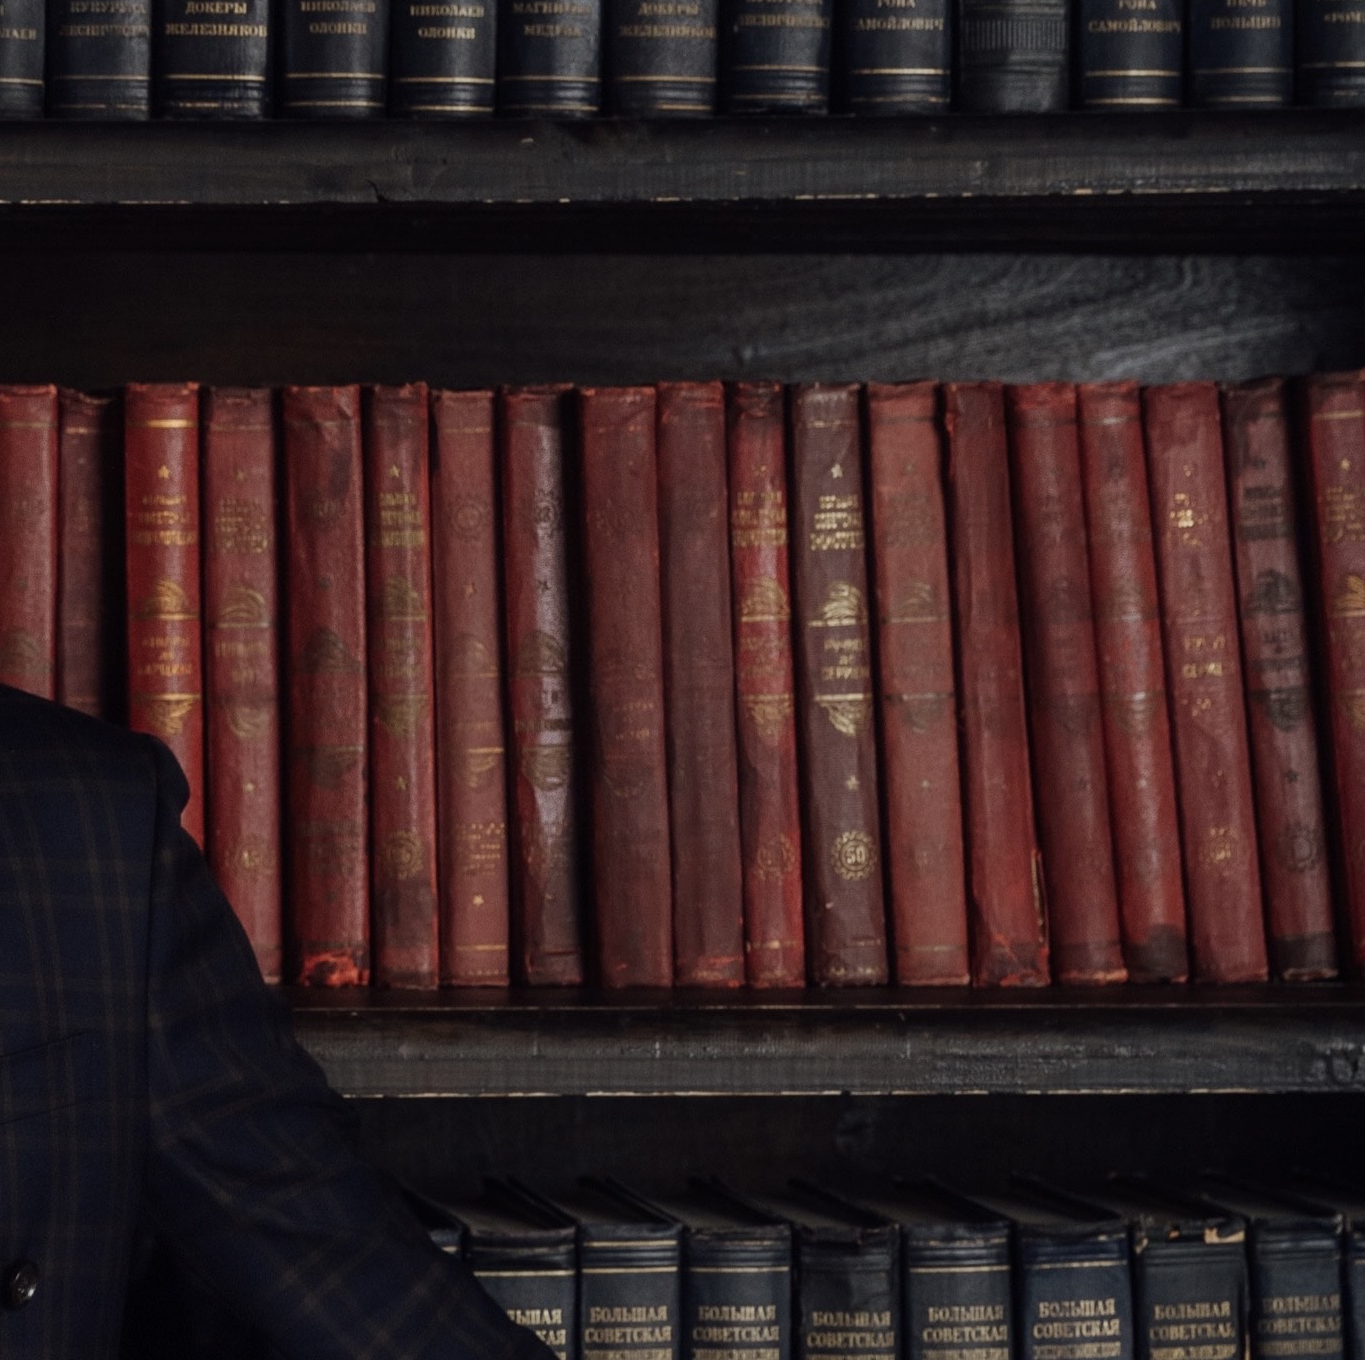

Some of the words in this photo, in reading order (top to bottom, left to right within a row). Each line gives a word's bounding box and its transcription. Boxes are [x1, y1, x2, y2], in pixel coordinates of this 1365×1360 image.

[186, 1, 249, 14] ДОКЕРЫ
[166, 23, 268, 38] ЖЕЛЕЗНЯКОВ
[845, 845, 865, 865] 50
[588, 1306, 669, 1321] БОЛЬШАЯ
[698, 1305, 776, 1320] БОЛЬШАЯ
[926, 1305, 1005, 1321] БОЛЬШАЯ
[1038, 1299, 1119, 1316] БОЛЬШАЯ
[1153, 1302, 1232, 1318] БОЛЬШАЯ
[811, 1311, 892, 1326] БОЛЬШАЯ
[584, 1327, 673, 1342] СОВЕТСКАЯ
[693, 1326, 780, 1340] СОВЕТСКАЯ
[922, 1326, 1008, 1342] СОВЕТСКАЯ
[1032, 1321, 1121, 1337] СОВЕТСКАЯ
[1148, 1324, 1235, 1339] СОВЕТСКАЯ
[805, 1332, 895, 1347] СОВЕТСКАЯ
